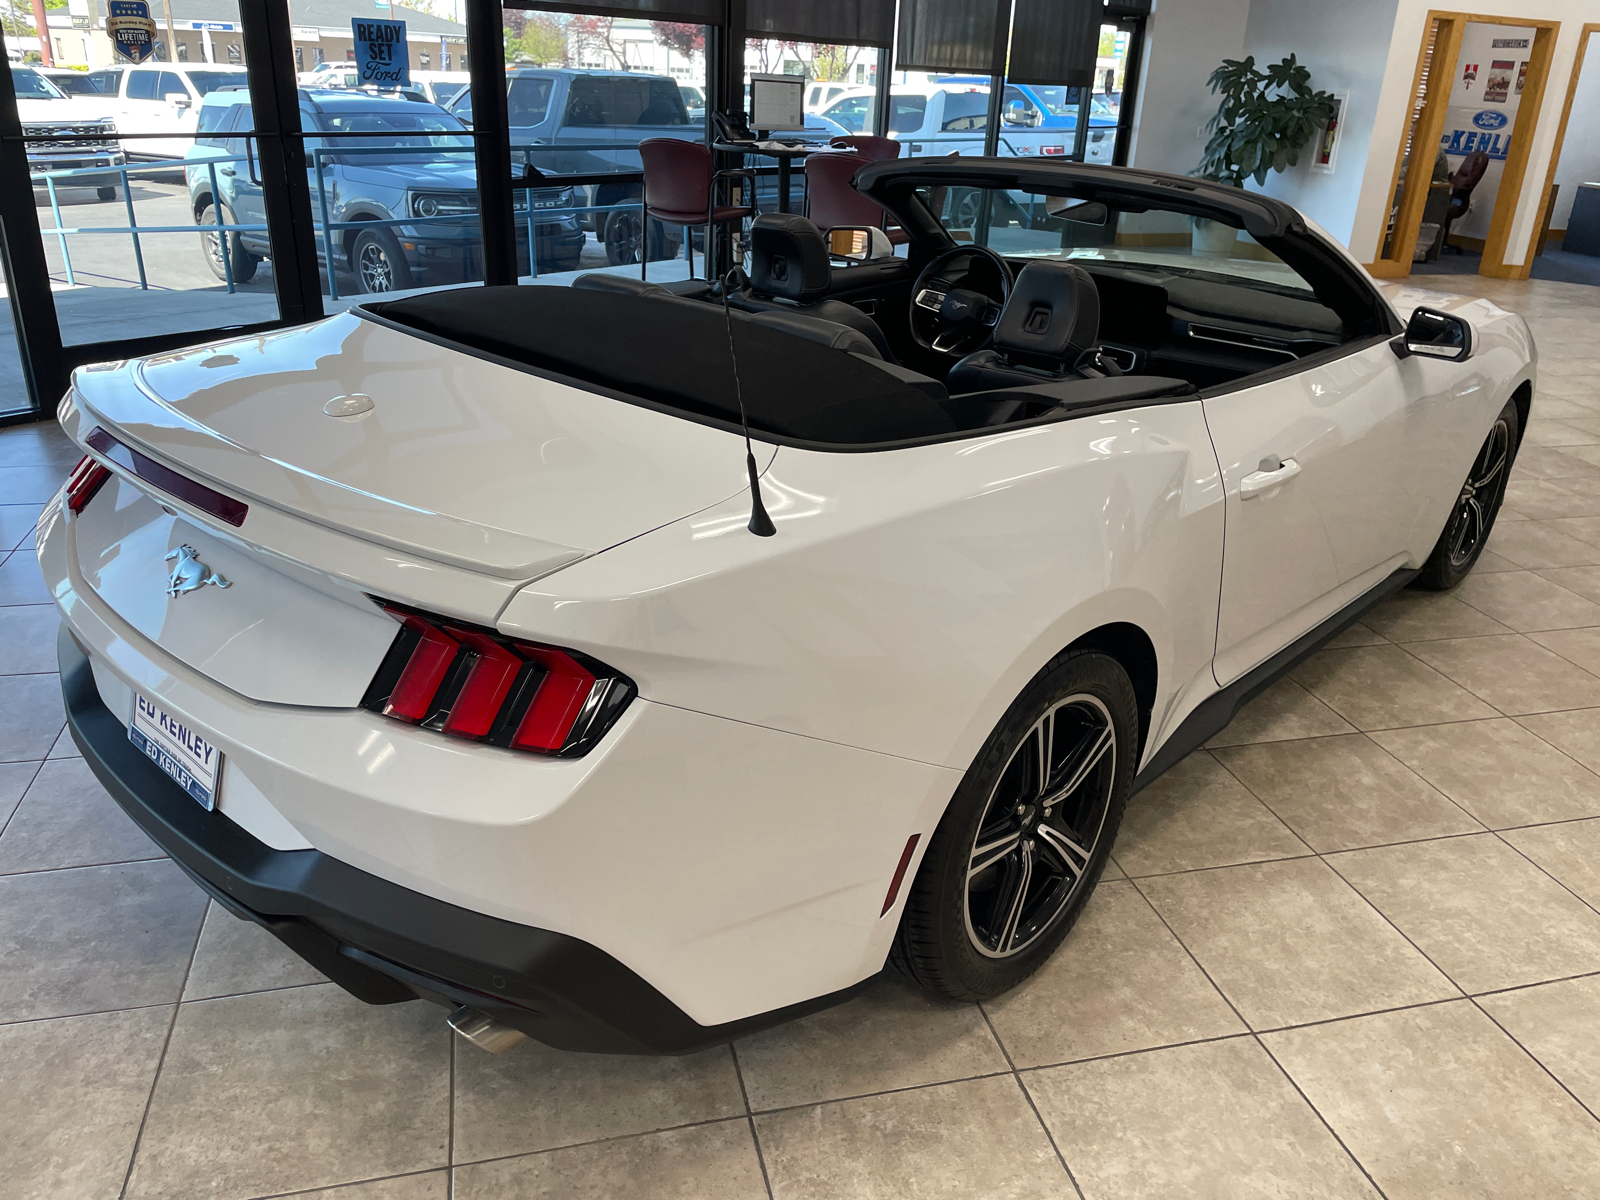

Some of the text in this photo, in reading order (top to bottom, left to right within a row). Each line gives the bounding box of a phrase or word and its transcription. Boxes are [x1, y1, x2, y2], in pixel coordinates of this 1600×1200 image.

[117, 33, 149, 41] LIFETIME
[357, 23, 401, 43] READY
[369, 43, 393, 61] SET
[363, 61, 402, 81] Ford
[1479, 112, 1502, 126] Ford
[1448, 130, 1511, 154] KENL
[139, 695, 155, 719] ED
[160, 711, 213, 765] KENLEY
[145, 740, 158, 760] ED
[159, 752, 193, 791] KENLEY
